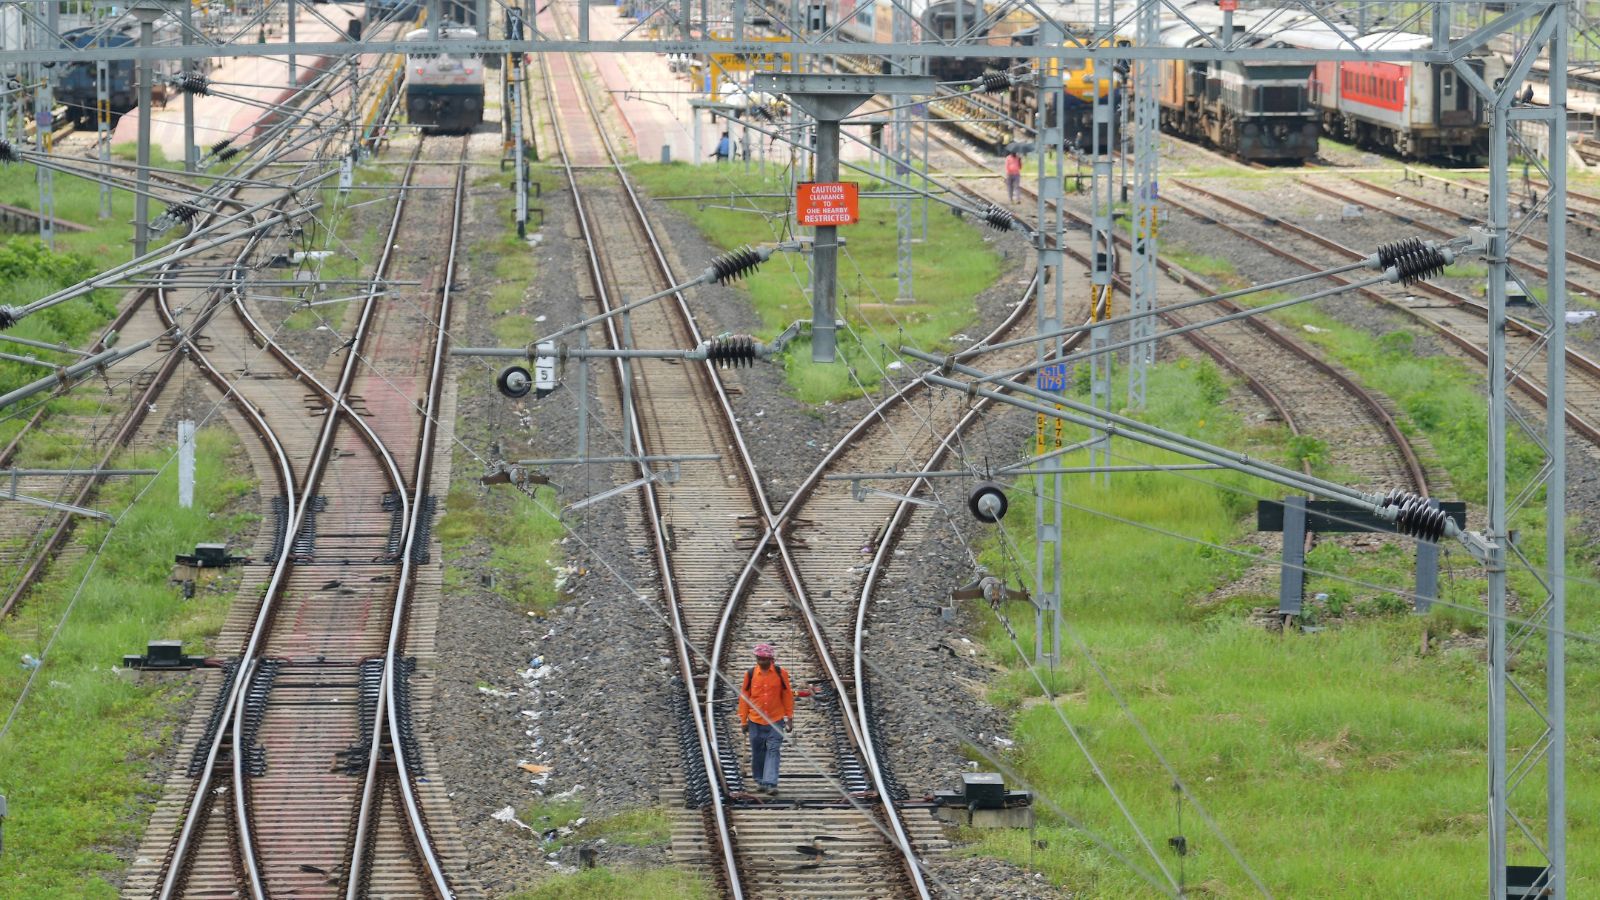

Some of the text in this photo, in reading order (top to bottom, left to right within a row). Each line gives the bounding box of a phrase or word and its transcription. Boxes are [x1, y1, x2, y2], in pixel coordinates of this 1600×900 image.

[804, 214, 850, 222] RESTRICTED
[541, 370, 548, 380] 5
[1041, 375, 1062, 389] 1179
